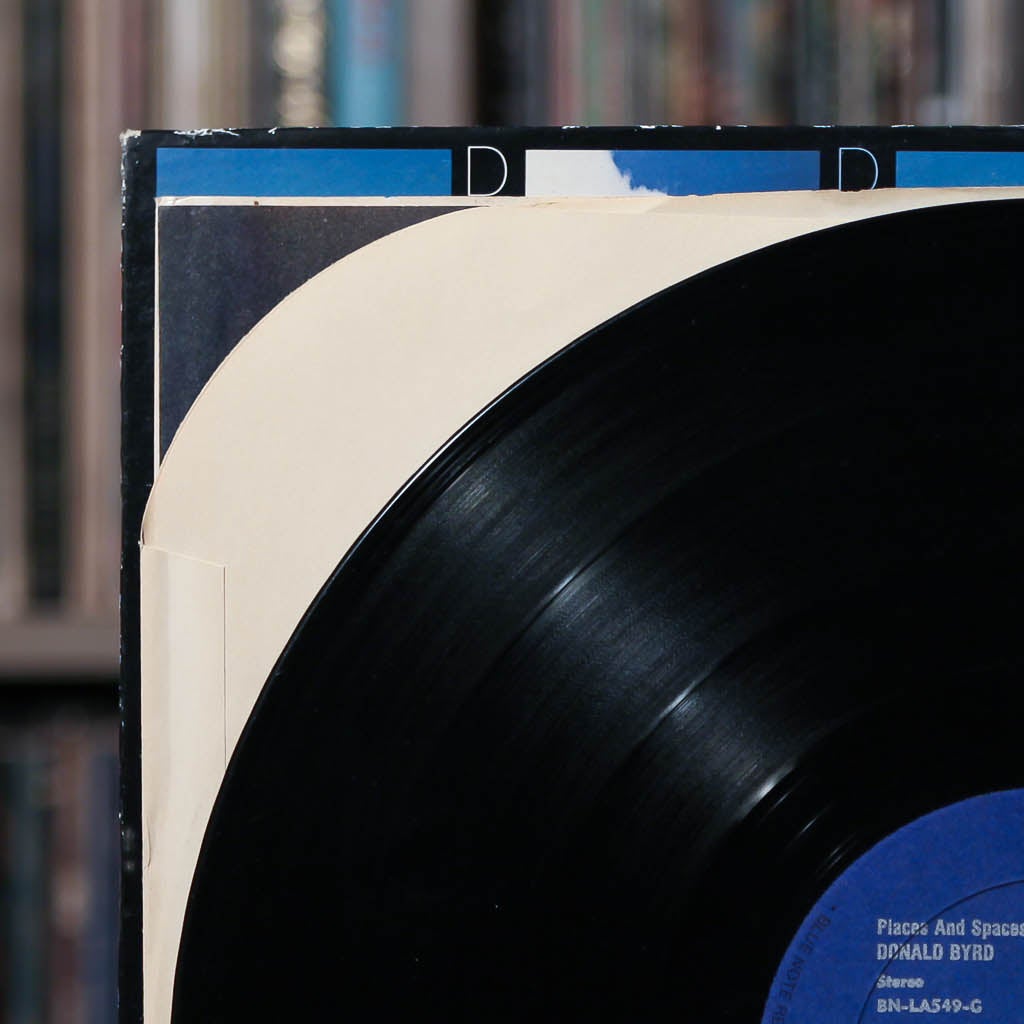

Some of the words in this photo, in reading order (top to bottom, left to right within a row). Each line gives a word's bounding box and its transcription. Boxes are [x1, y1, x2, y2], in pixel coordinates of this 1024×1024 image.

[467, 146, 508, 196] D
[838, 147, 879, 190] D
[797, 911, 831, 954] BLUE
[877, 919, 928, 936] Places
[935, 919, 965, 936] And
[877, 944, 943, 960] DONALD
[950, 944, 994, 961] BYRD
[776, 954, 806, 1001] NOTE
[877, 975, 924, 989] Stereo
[877, 998, 983, 1014] BN-LA549-G
